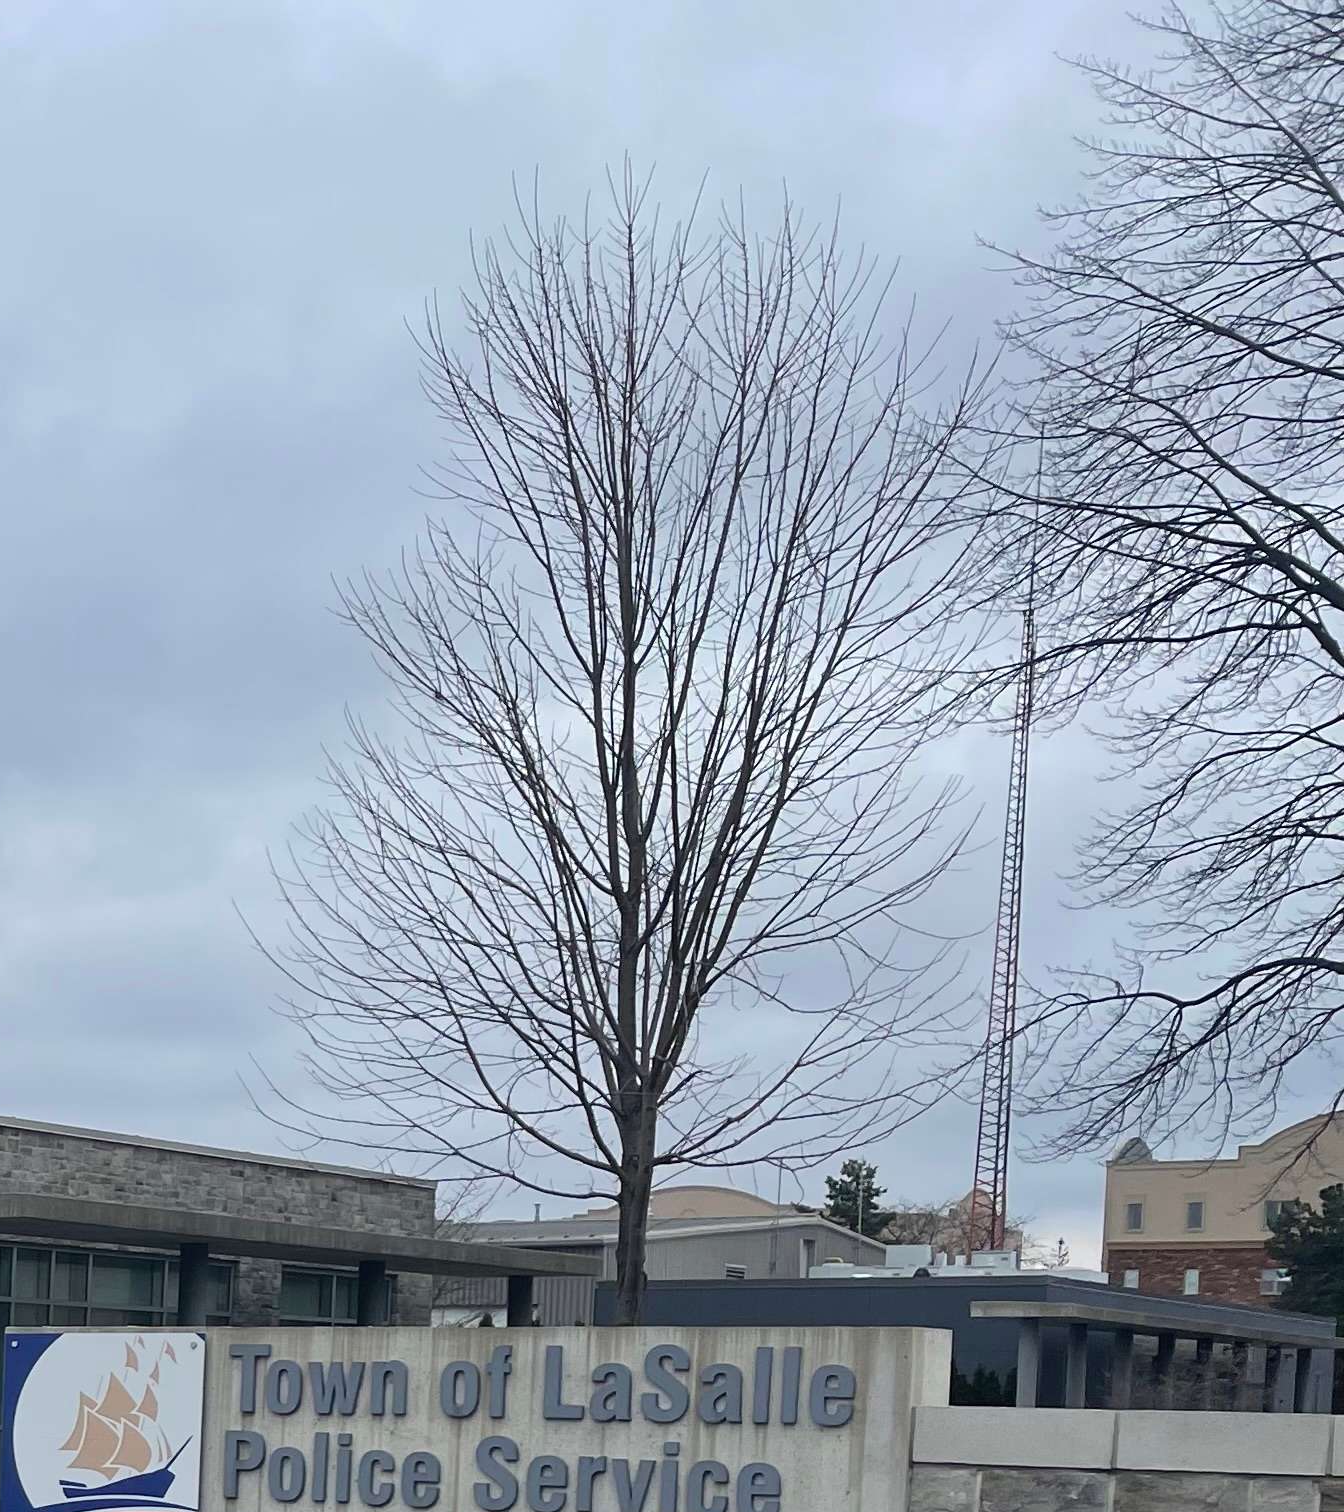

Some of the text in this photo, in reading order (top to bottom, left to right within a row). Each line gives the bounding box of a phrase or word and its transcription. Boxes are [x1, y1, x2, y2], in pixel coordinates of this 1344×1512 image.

[228, 1343, 858, 1428] Town of LaSalle
[223, 1429, 442, 1510] Police
